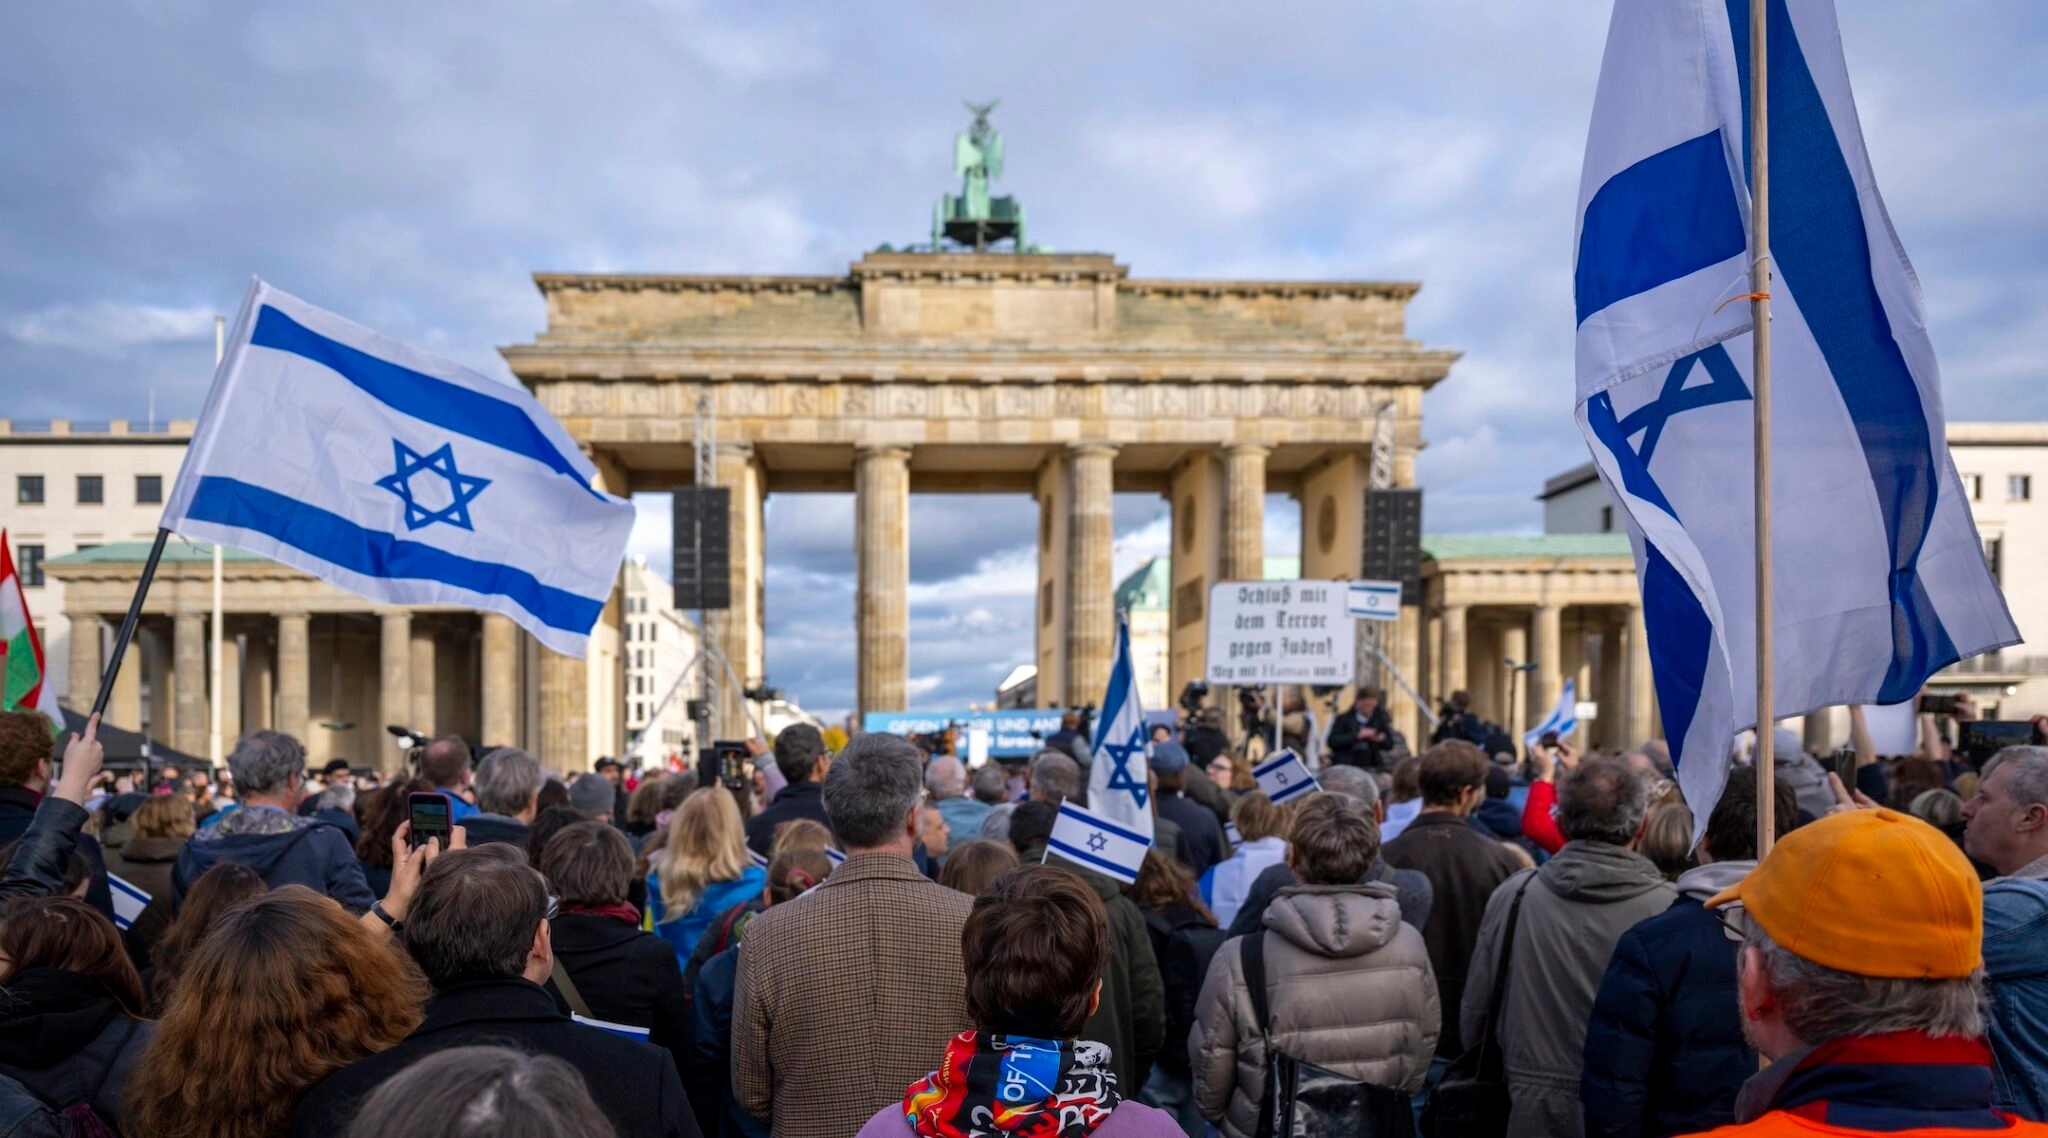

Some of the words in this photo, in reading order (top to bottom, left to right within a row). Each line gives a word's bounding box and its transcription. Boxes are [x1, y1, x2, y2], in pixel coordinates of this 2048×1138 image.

[1300, 586, 1327, 602] mit
[1235, 614, 1264, 629] dem
[1276, 610, 1327, 629] Terror
[1229, 641, 1272, 659] gegen
[942, 1051, 954, 1087] WHISK
[1003, 1070, 1027, 1102] OF
